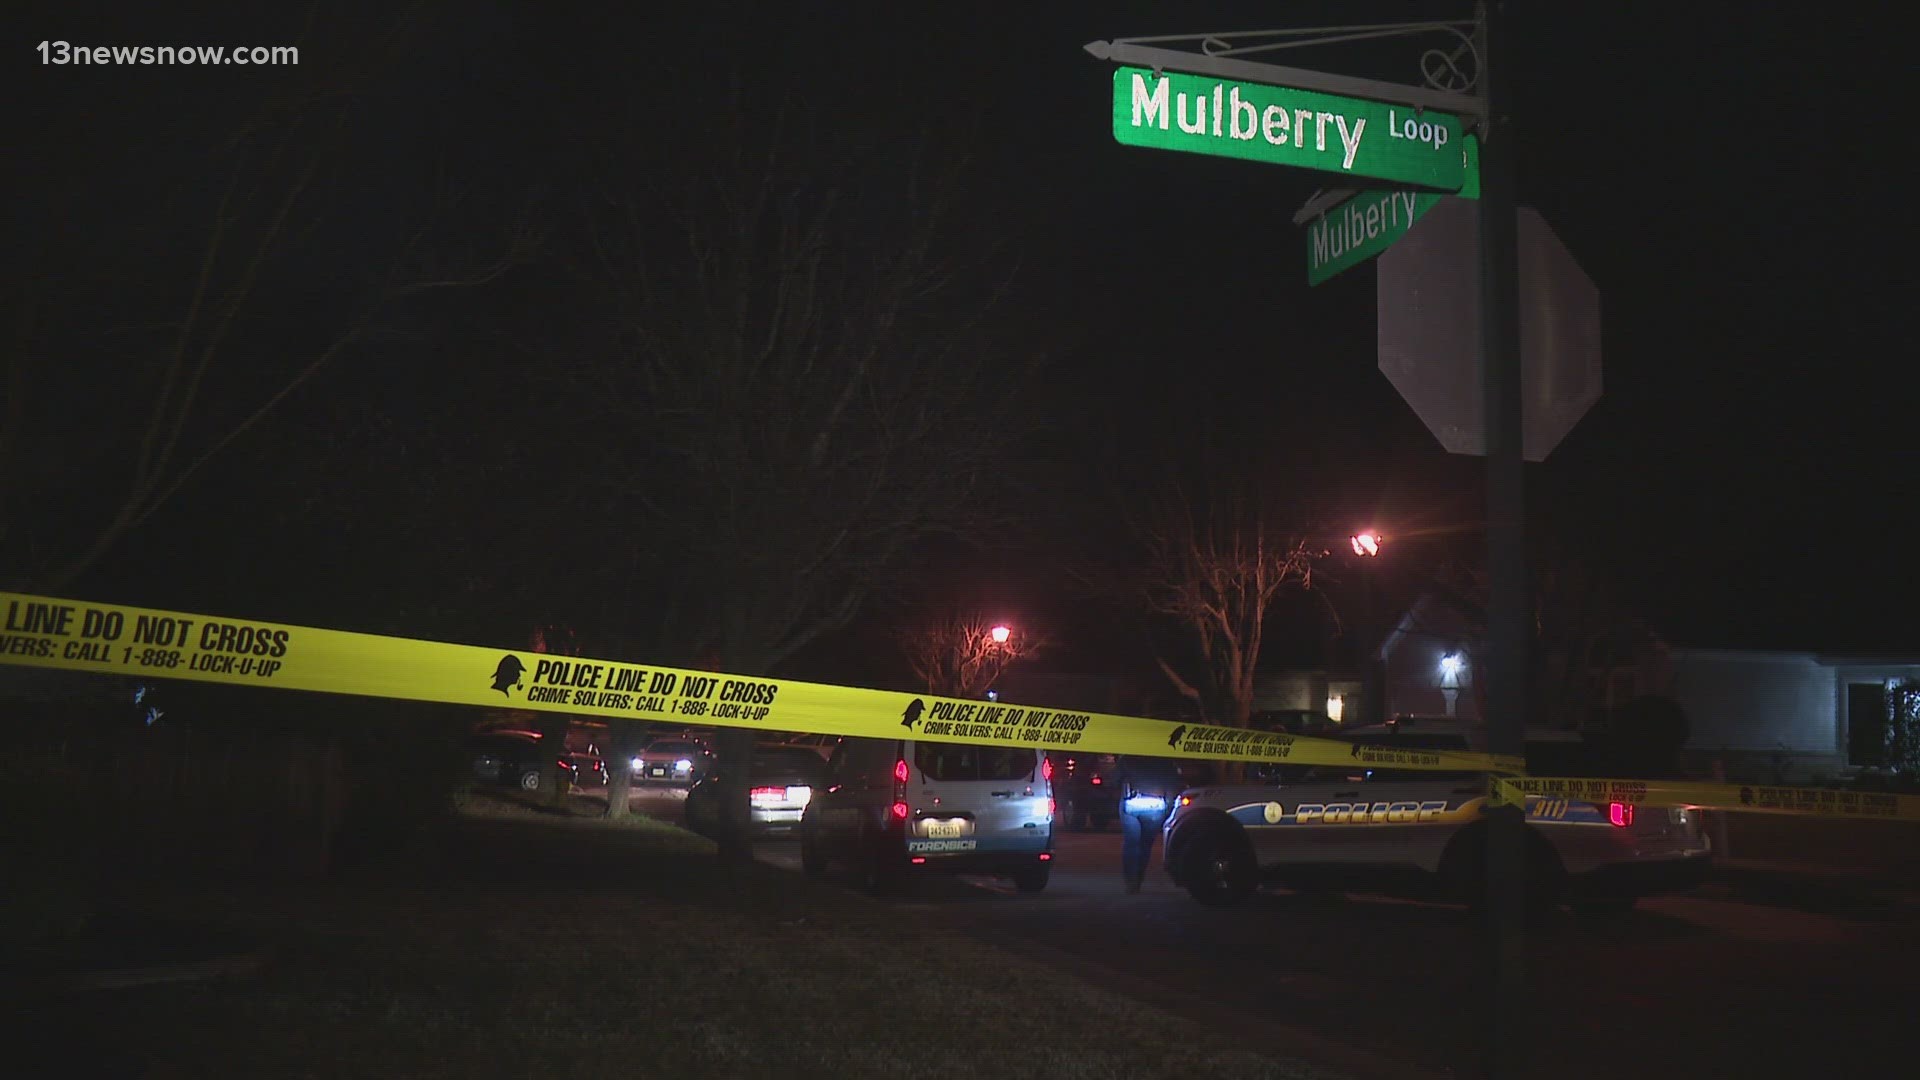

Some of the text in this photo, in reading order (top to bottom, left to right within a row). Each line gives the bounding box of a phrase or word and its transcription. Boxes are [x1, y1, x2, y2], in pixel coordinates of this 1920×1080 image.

[1131, 73, 1448, 169] Mulberry Loop
[1313, 191, 1416, 269] Mulberry
[5, 600, 289, 657] LINE DO NOT CROSS
[63, 641, 111, 662] CALL
[533, 659, 778, 705] POLICE LINE DO NOT CROSS
[527, 686, 572, 704] CRIME
[572, 690, 634, 709] SOLVERS:
[635, 695, 665, 712] CALL
[929, 702, 1090, 731] POLICE LINE DO NOT CROSS
[924, 721, 951, 736] CRIME
[953, 723, 993, 738] SOLVERS:
[993, 726, 1013, 740] CALL
[1543, 780, 1565, 792] LINE
[1568, 781, 1584, 792] DO
[1587, 781, 1608, 793] NOT
[1296, 801, 1447, 825] POLICE
[909, 840, 977, 851] FORENSICS
